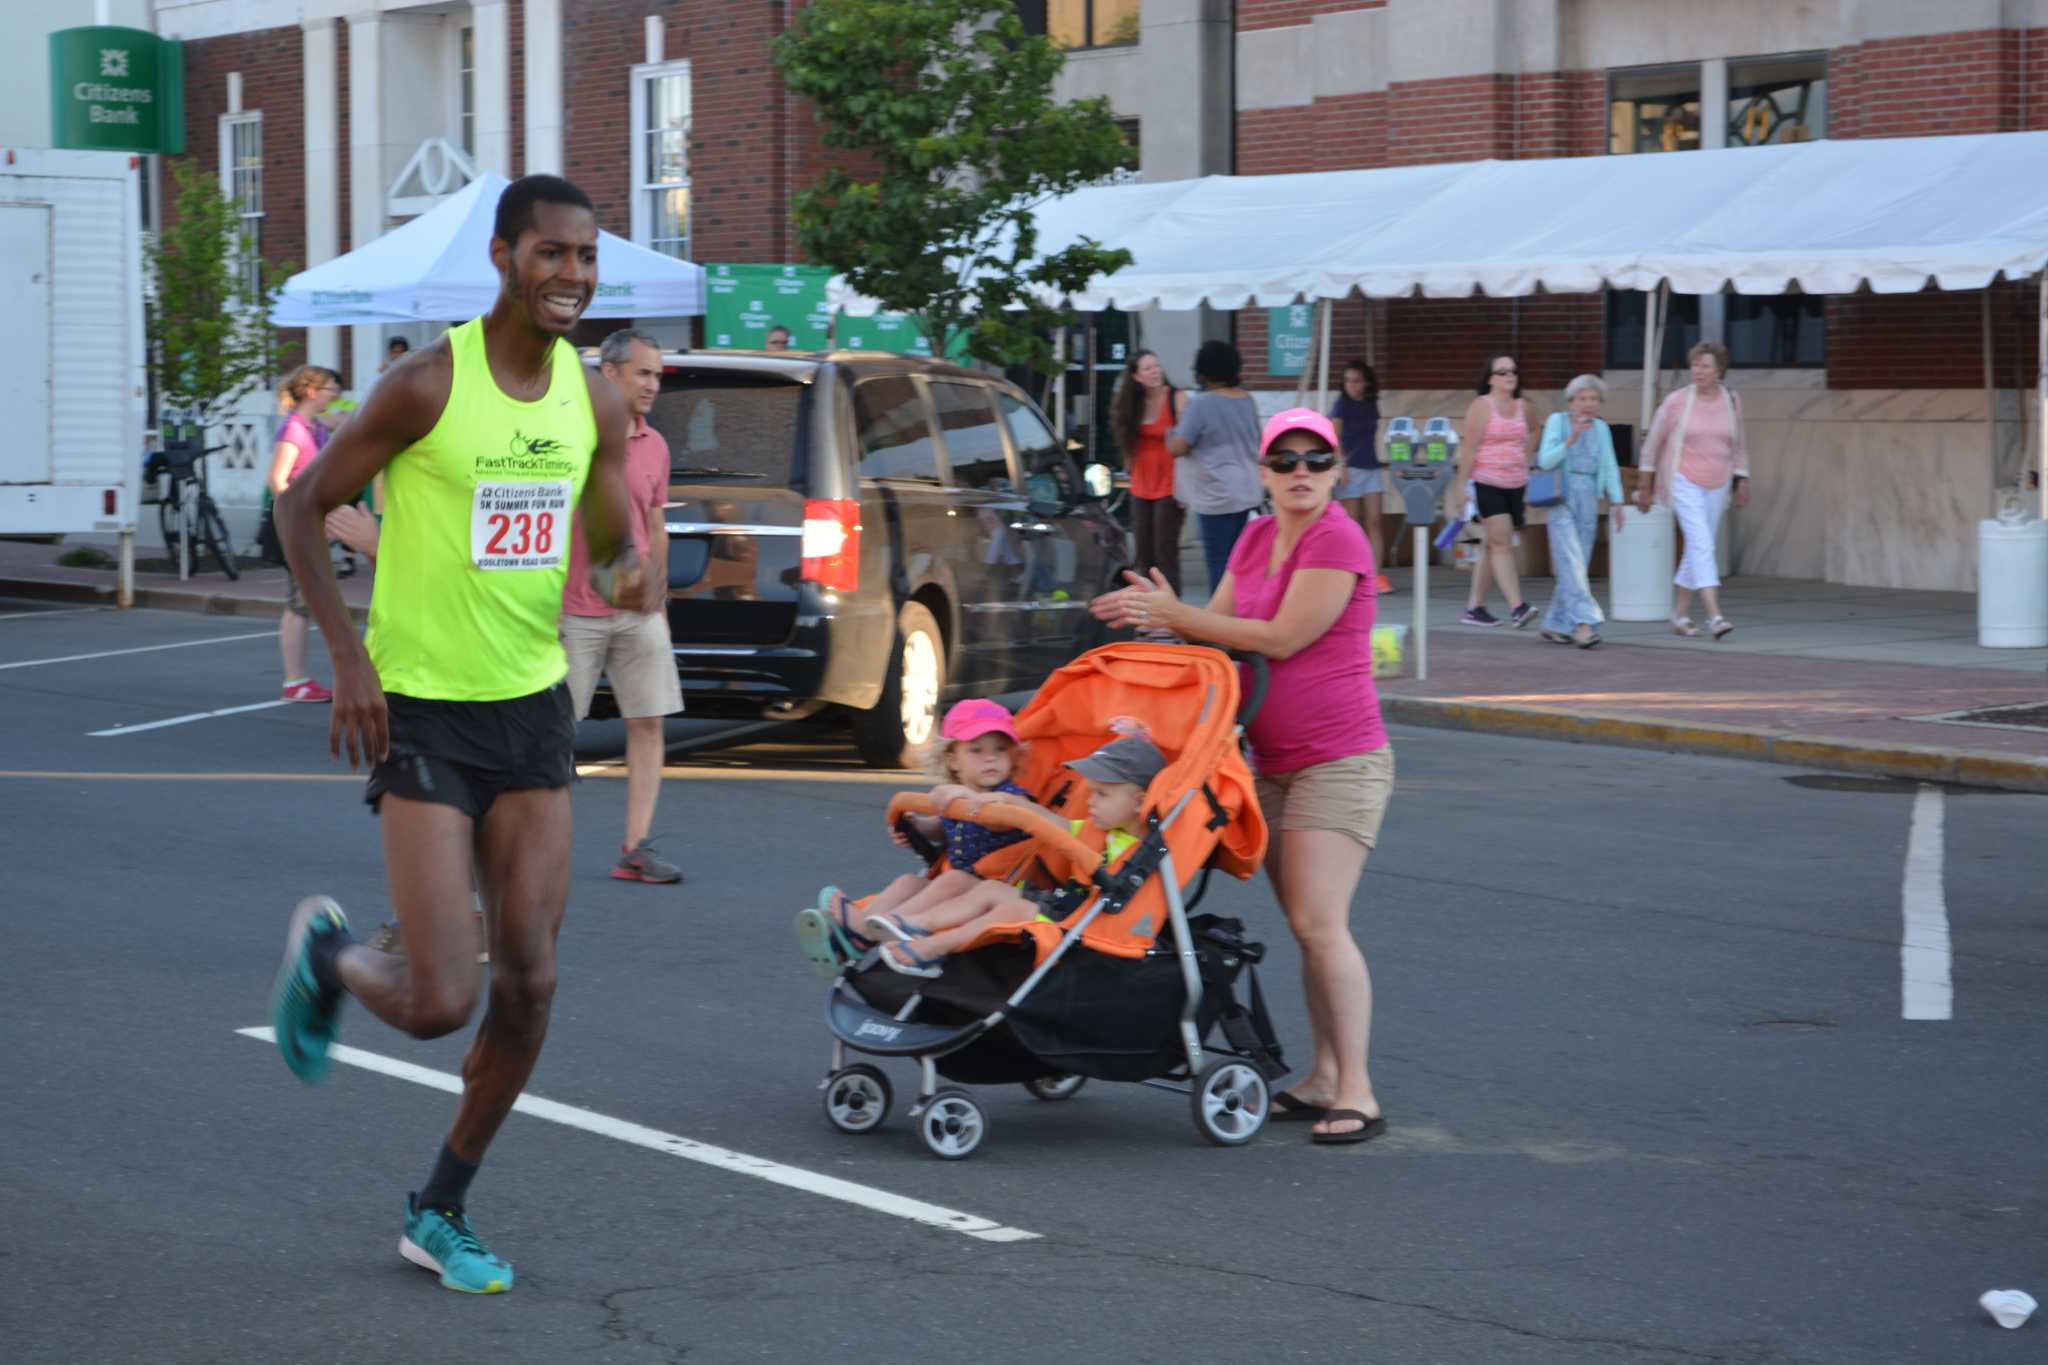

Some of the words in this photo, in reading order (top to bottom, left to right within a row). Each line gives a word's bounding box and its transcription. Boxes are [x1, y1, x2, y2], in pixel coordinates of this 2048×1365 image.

[73, 82, 152, 103] Citizens
[89, 105, 139, 124] Bank
[494, 487, 535, 498] Citizens
[537, 485, 564, 497] Bank
[494, 500, 529, 511] SUMMER
[485, 511, 555, 555] 238
